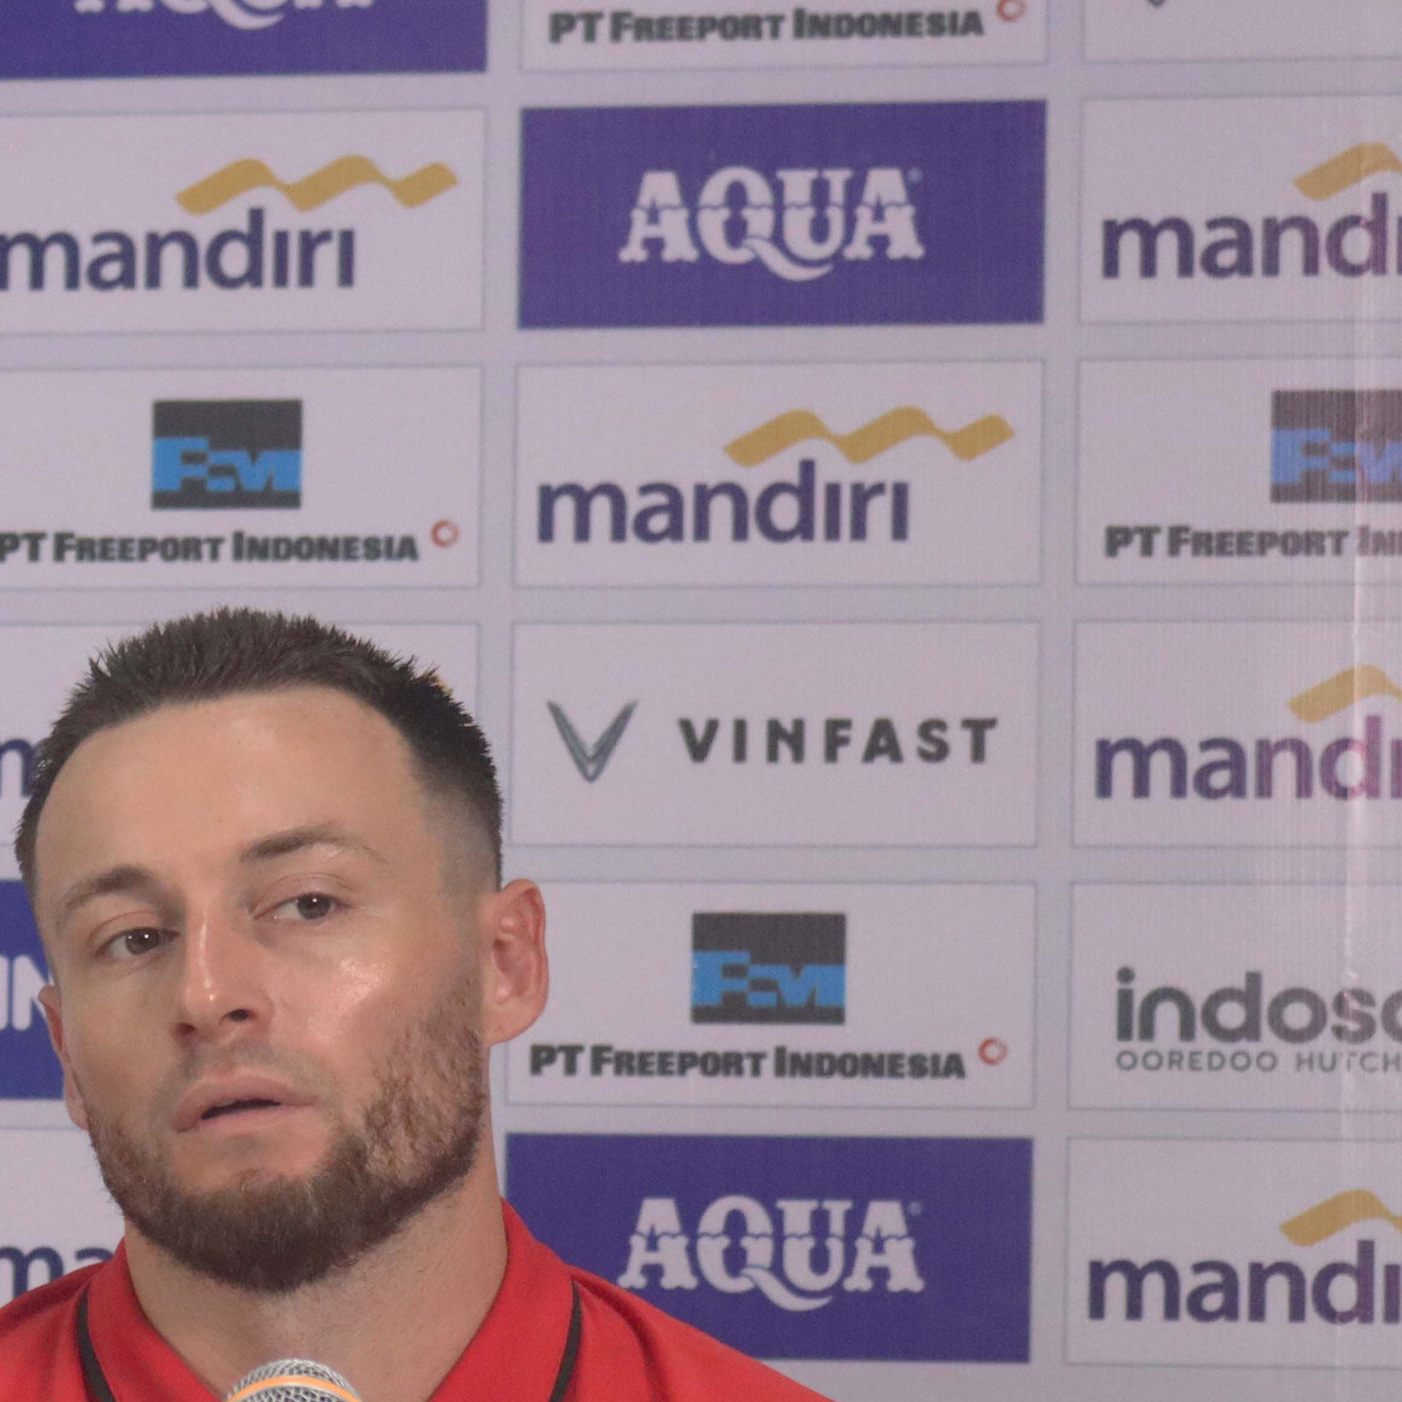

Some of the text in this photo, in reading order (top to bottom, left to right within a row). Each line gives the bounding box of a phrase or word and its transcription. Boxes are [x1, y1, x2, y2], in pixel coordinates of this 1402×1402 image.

[549, 7, 984, 44] PT FREEPORT INDONESIA
[619, 166, 924, 281] AQUA
[1102, 192, 1402, 279] mand
[537, 458, 909, 544] mandiri
[53, 531, 225, 563] FREEPORT
[232, 530, 419, 562] INDONESIA
[1105, 525, 1162, 558] PT
[1167, 524, 1349, 558] FREEPORT
[678, 717, 998, 764] VINFAST
[529, 1044, 966, 1079] PT FREEPORT INDONESIA
[1115, 1050, 1278, 1072] OOREDOO
[617, 1195, 924, 1311] AQUA
